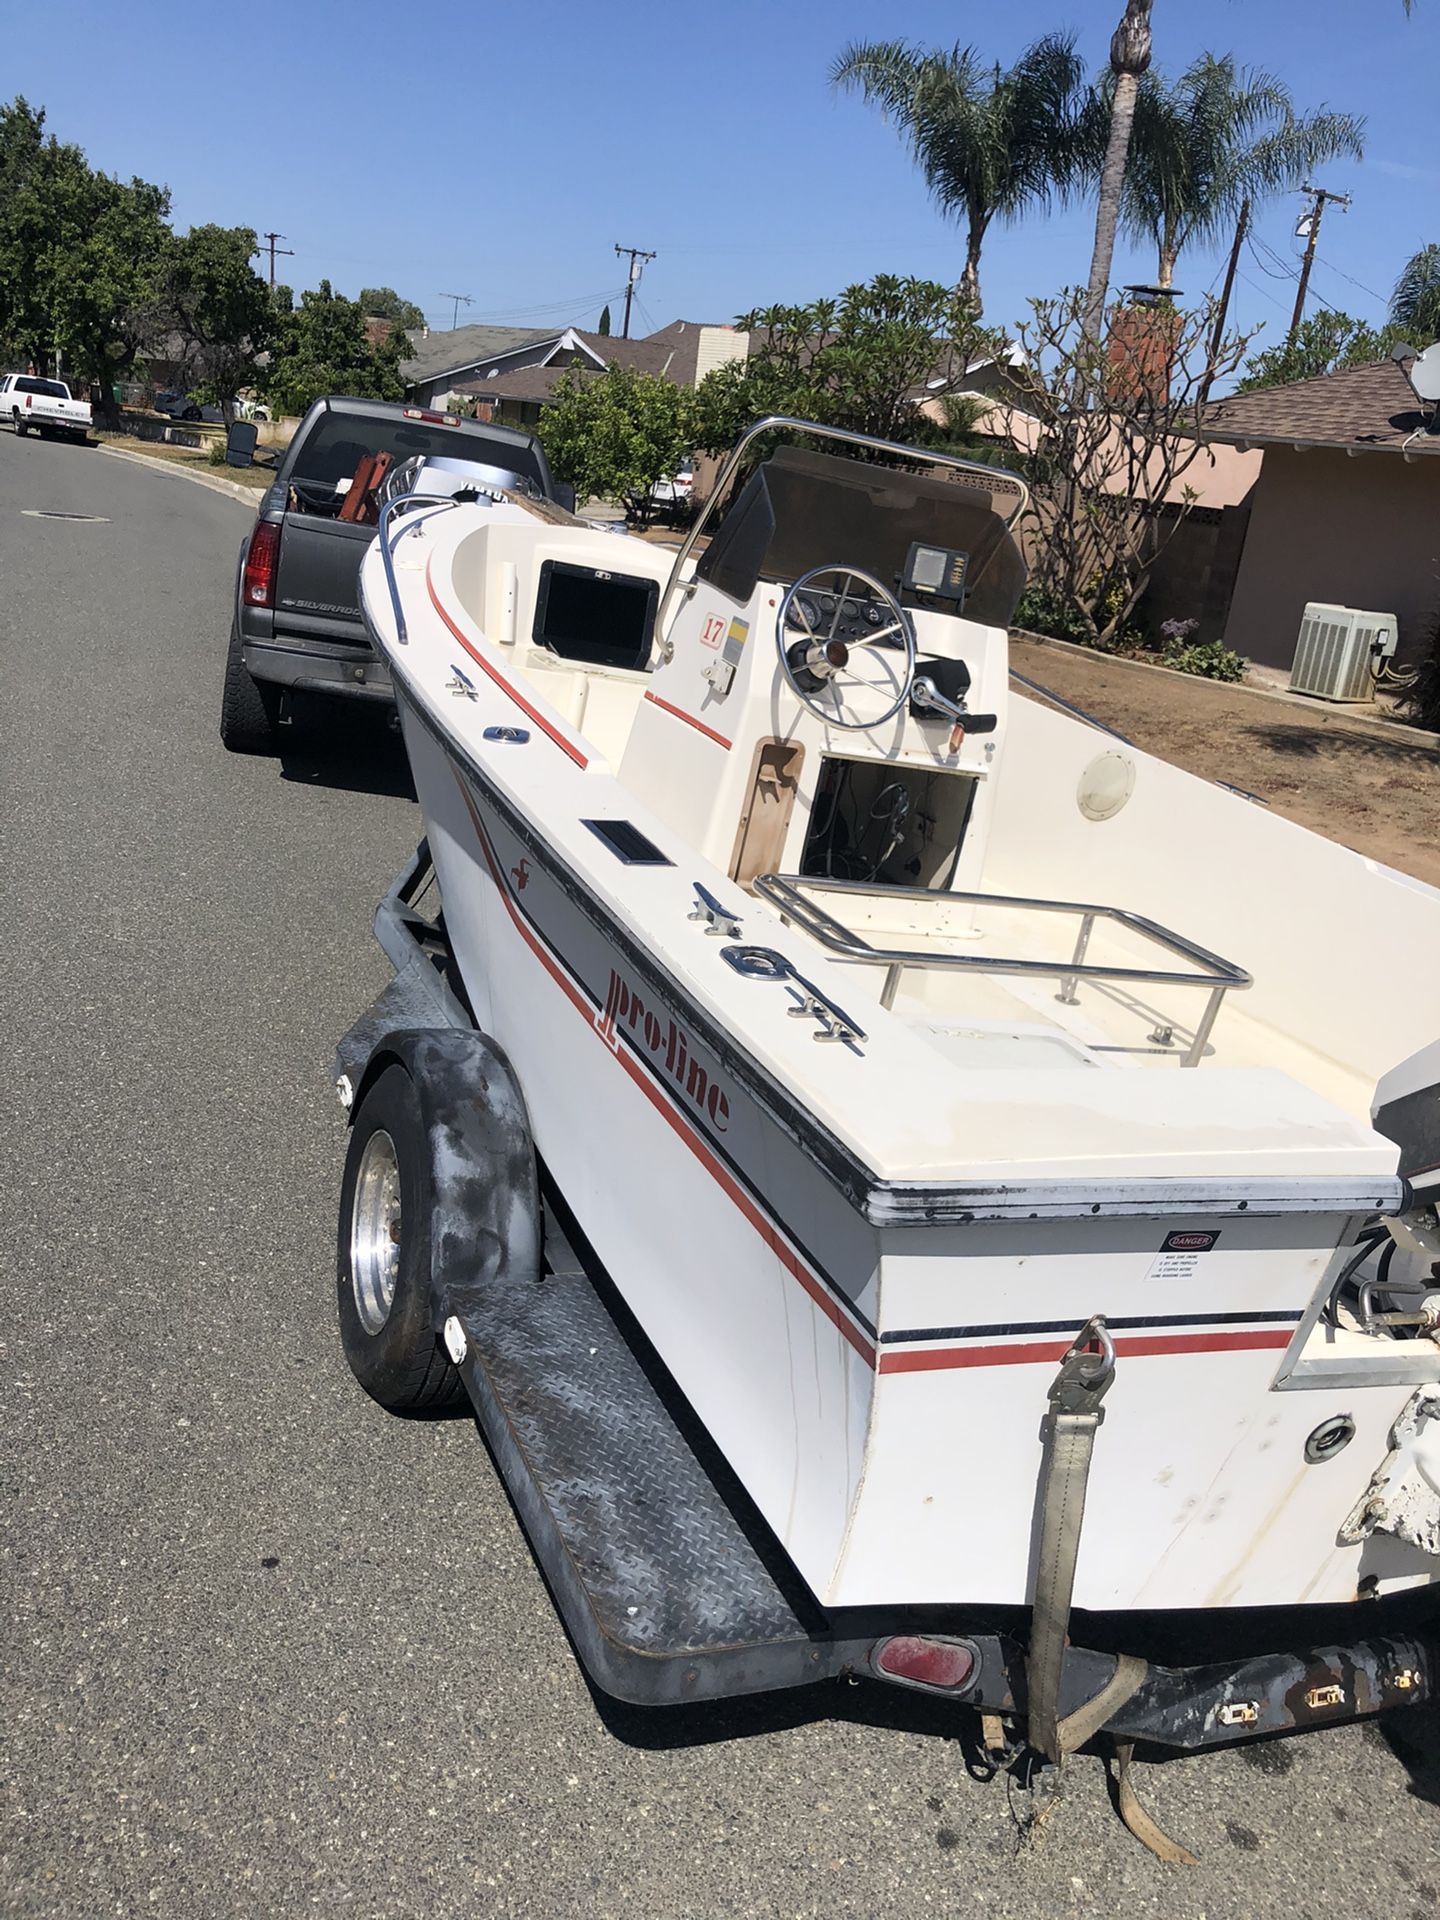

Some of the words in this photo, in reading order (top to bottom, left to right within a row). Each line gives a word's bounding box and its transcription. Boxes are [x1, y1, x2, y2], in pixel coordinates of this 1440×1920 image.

[37, 406, 85, 417] CHEVROLET
[295, 600, 361, 615] SILVERADO
[703, 618, 724, 642] 17
[1172, 1237, 1209, 1245] DANGER
